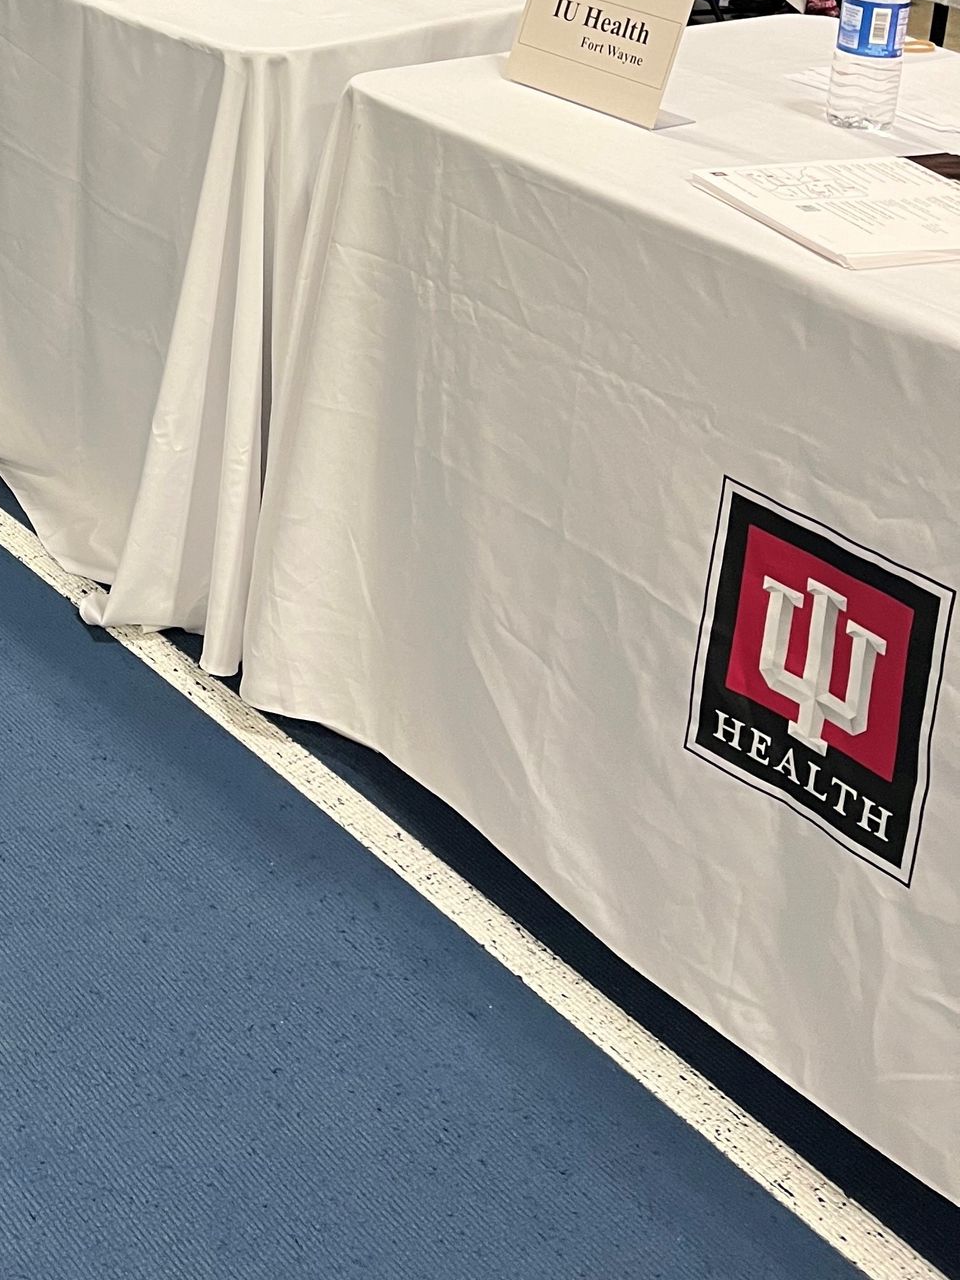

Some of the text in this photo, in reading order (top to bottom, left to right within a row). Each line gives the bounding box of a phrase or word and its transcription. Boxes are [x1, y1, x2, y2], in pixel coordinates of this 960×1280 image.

[582, 6, 650, 45] Health
[580, 36, 644, 68] Fort Wayne
[712, 708, 895, 843] HEALTH
